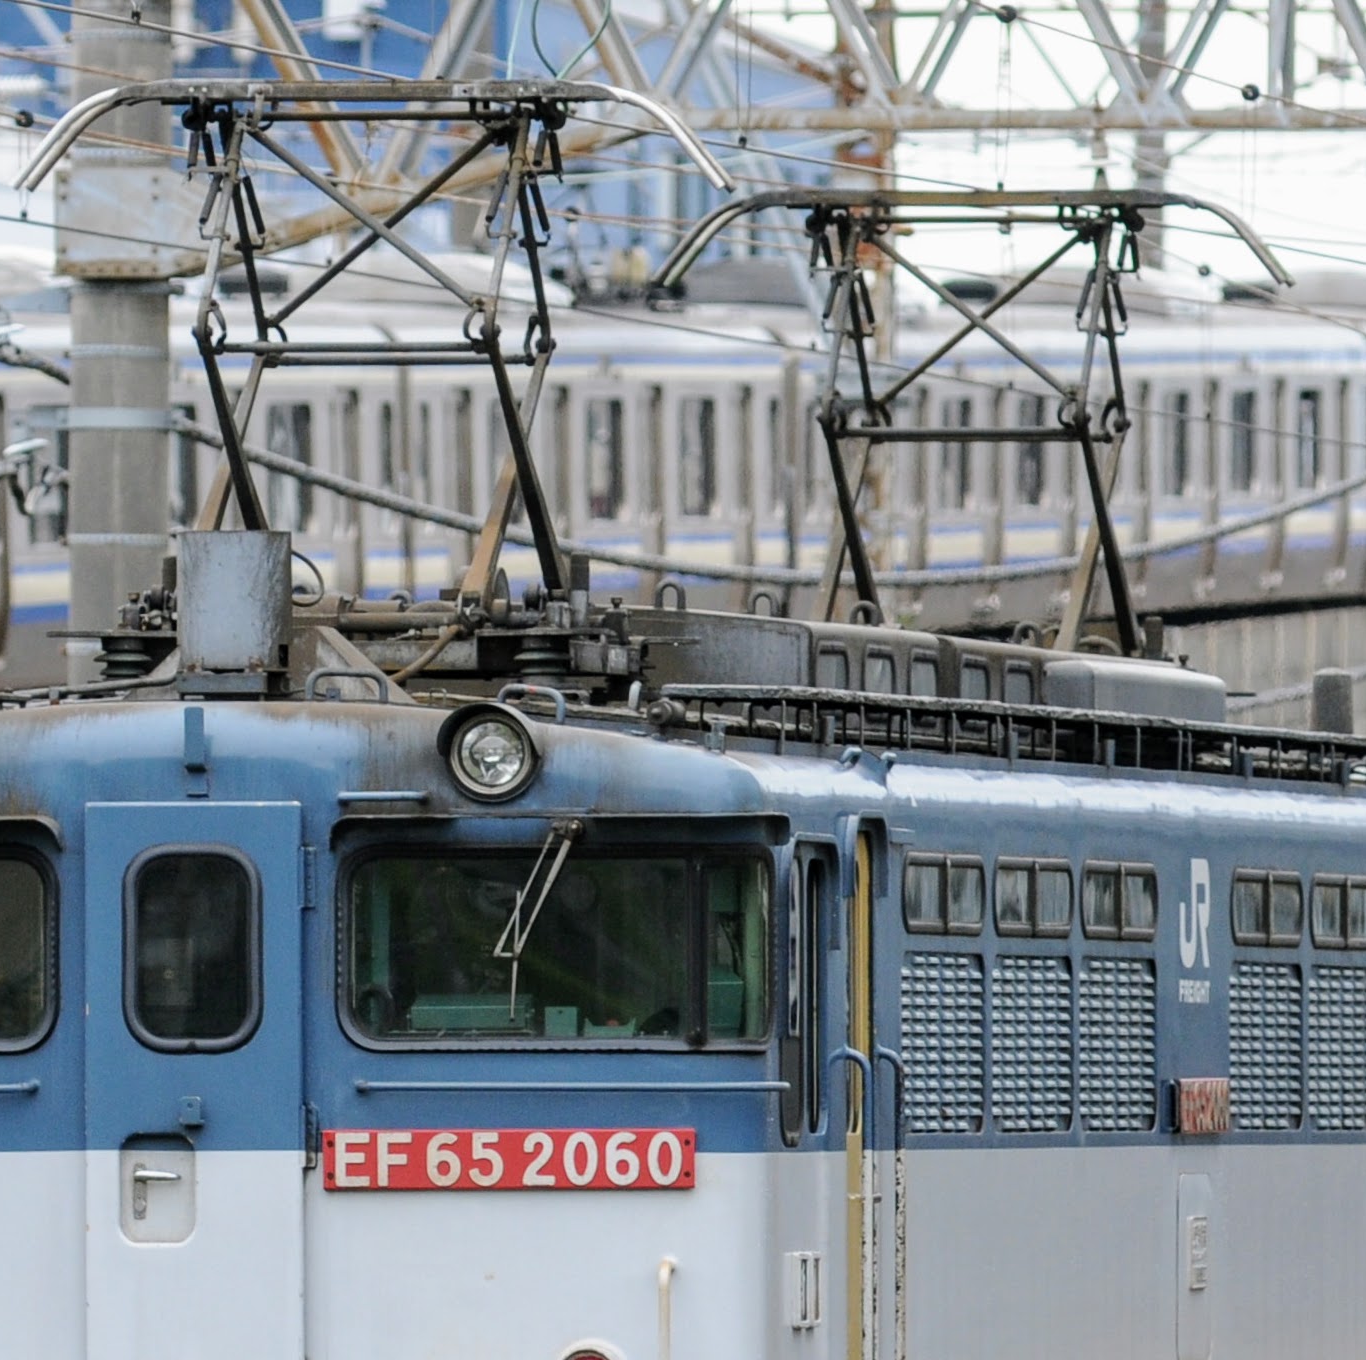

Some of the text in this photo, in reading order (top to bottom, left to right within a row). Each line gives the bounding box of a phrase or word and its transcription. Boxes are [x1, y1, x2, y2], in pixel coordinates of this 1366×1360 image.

[1179, 857, 1210, 969] JR
[1178, 978, 1211, 1004] FREIGHT
[522, 1130, 683, 1188] 2060
